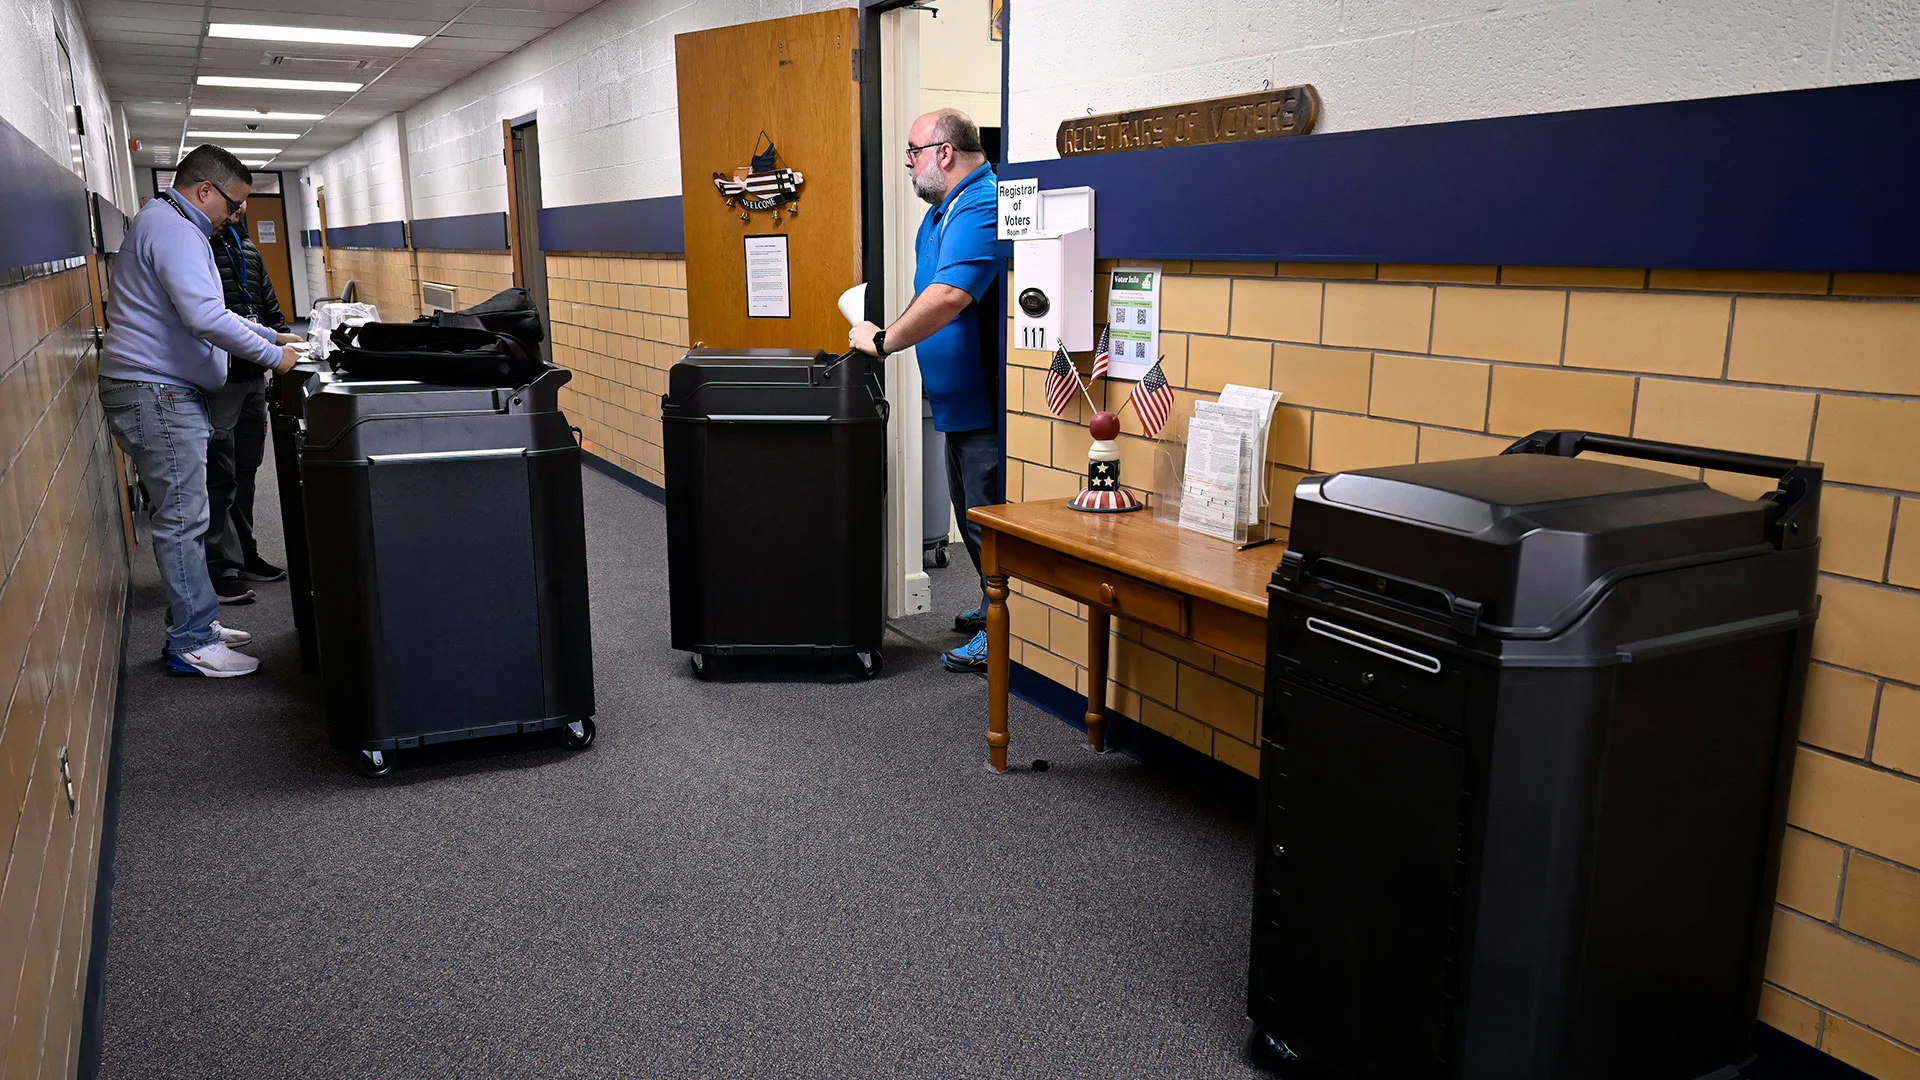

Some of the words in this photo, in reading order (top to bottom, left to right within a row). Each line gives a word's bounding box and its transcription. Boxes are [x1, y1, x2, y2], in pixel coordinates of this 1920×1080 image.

[1174, 111, 1199, 143] OF
[1210, 97, 1297, 138] VOTERS
[999, 184, 1037, 199] Registrar
[742, 198, 777, 210] WELCOME
[1013, 199, 1022, 211] of
[1004, 215, 1031, 226] Voters
[1114, 275, 1128, 283] Voter
[1128, 276, 1140, 284] Info
[1023, 326, 1045, 349] 117
